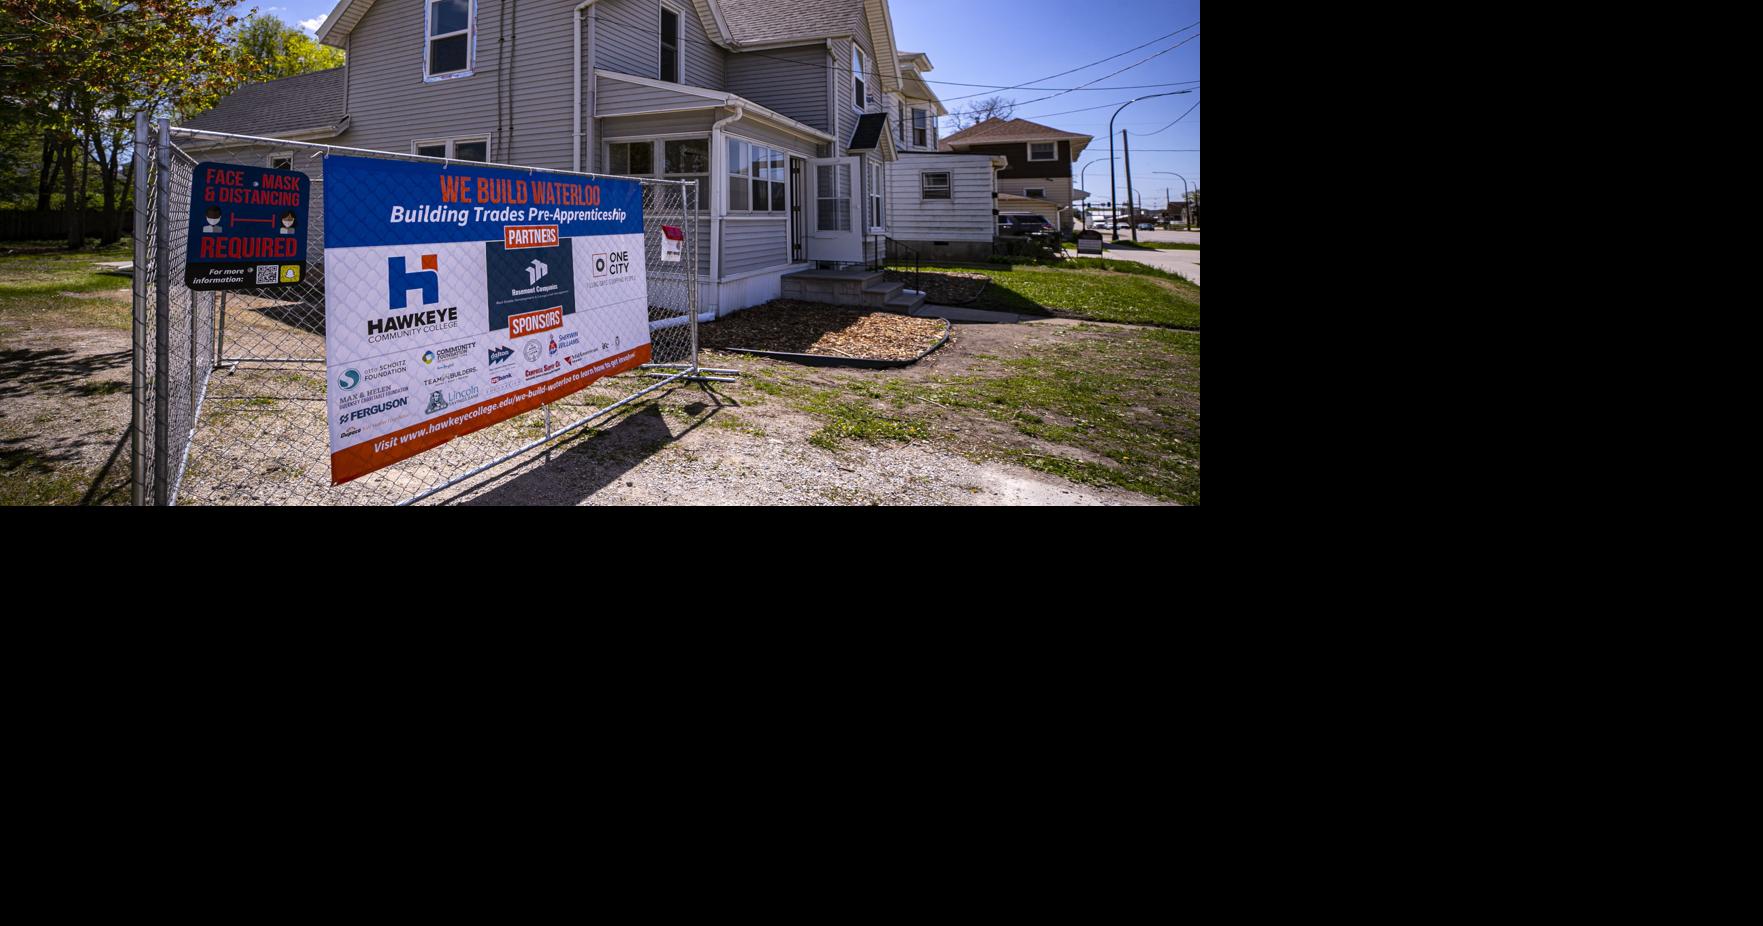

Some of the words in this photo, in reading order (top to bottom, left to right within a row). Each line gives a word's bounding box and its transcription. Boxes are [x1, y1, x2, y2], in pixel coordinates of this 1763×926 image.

[205, 168, 245, 187] FACE
[261, 174, 300, 191] MASK
[204, 186, 215, 202] &
[219, 187, 300, 207] DISTANCING
[440, 175, 472, 204] WE
[477, 176, 528, 206] BUILD
[531, 180, 601, 206] WATERLOO
[390, 205, 469, 227] Building
[474, 207, 525, 223] Trades
[528, 207, 627, 224] Pre-Apprenticeship
[200, 236, 298, 259] REQUIRED
[508, 228, 557, 246] PARTNERS
[609, 251, 629, 263] ONE
[209, 268, 222, 276] For
[609, 262, 629, 275] CITY
[192, 276, 244, 285] information:
[367, 307, 458, 335] HAWKEYE
[512, 310, 560, 335] SPONSORS
[368, 327, 422, 344] COMMUNITY
[423, 320, 458, 333] COLLEGE
[436, 342, 476, 356] COMMUNITY
[364, 367, 407, 381] FOUNDATION
[340, 393, 358, 404] MAX
[367, 385, 392, 397] HELEN
[350, 396, 408, 422] FERGUSON
[374, 437, 398, 453] Visit
[580, 368, 595, 378] learn
